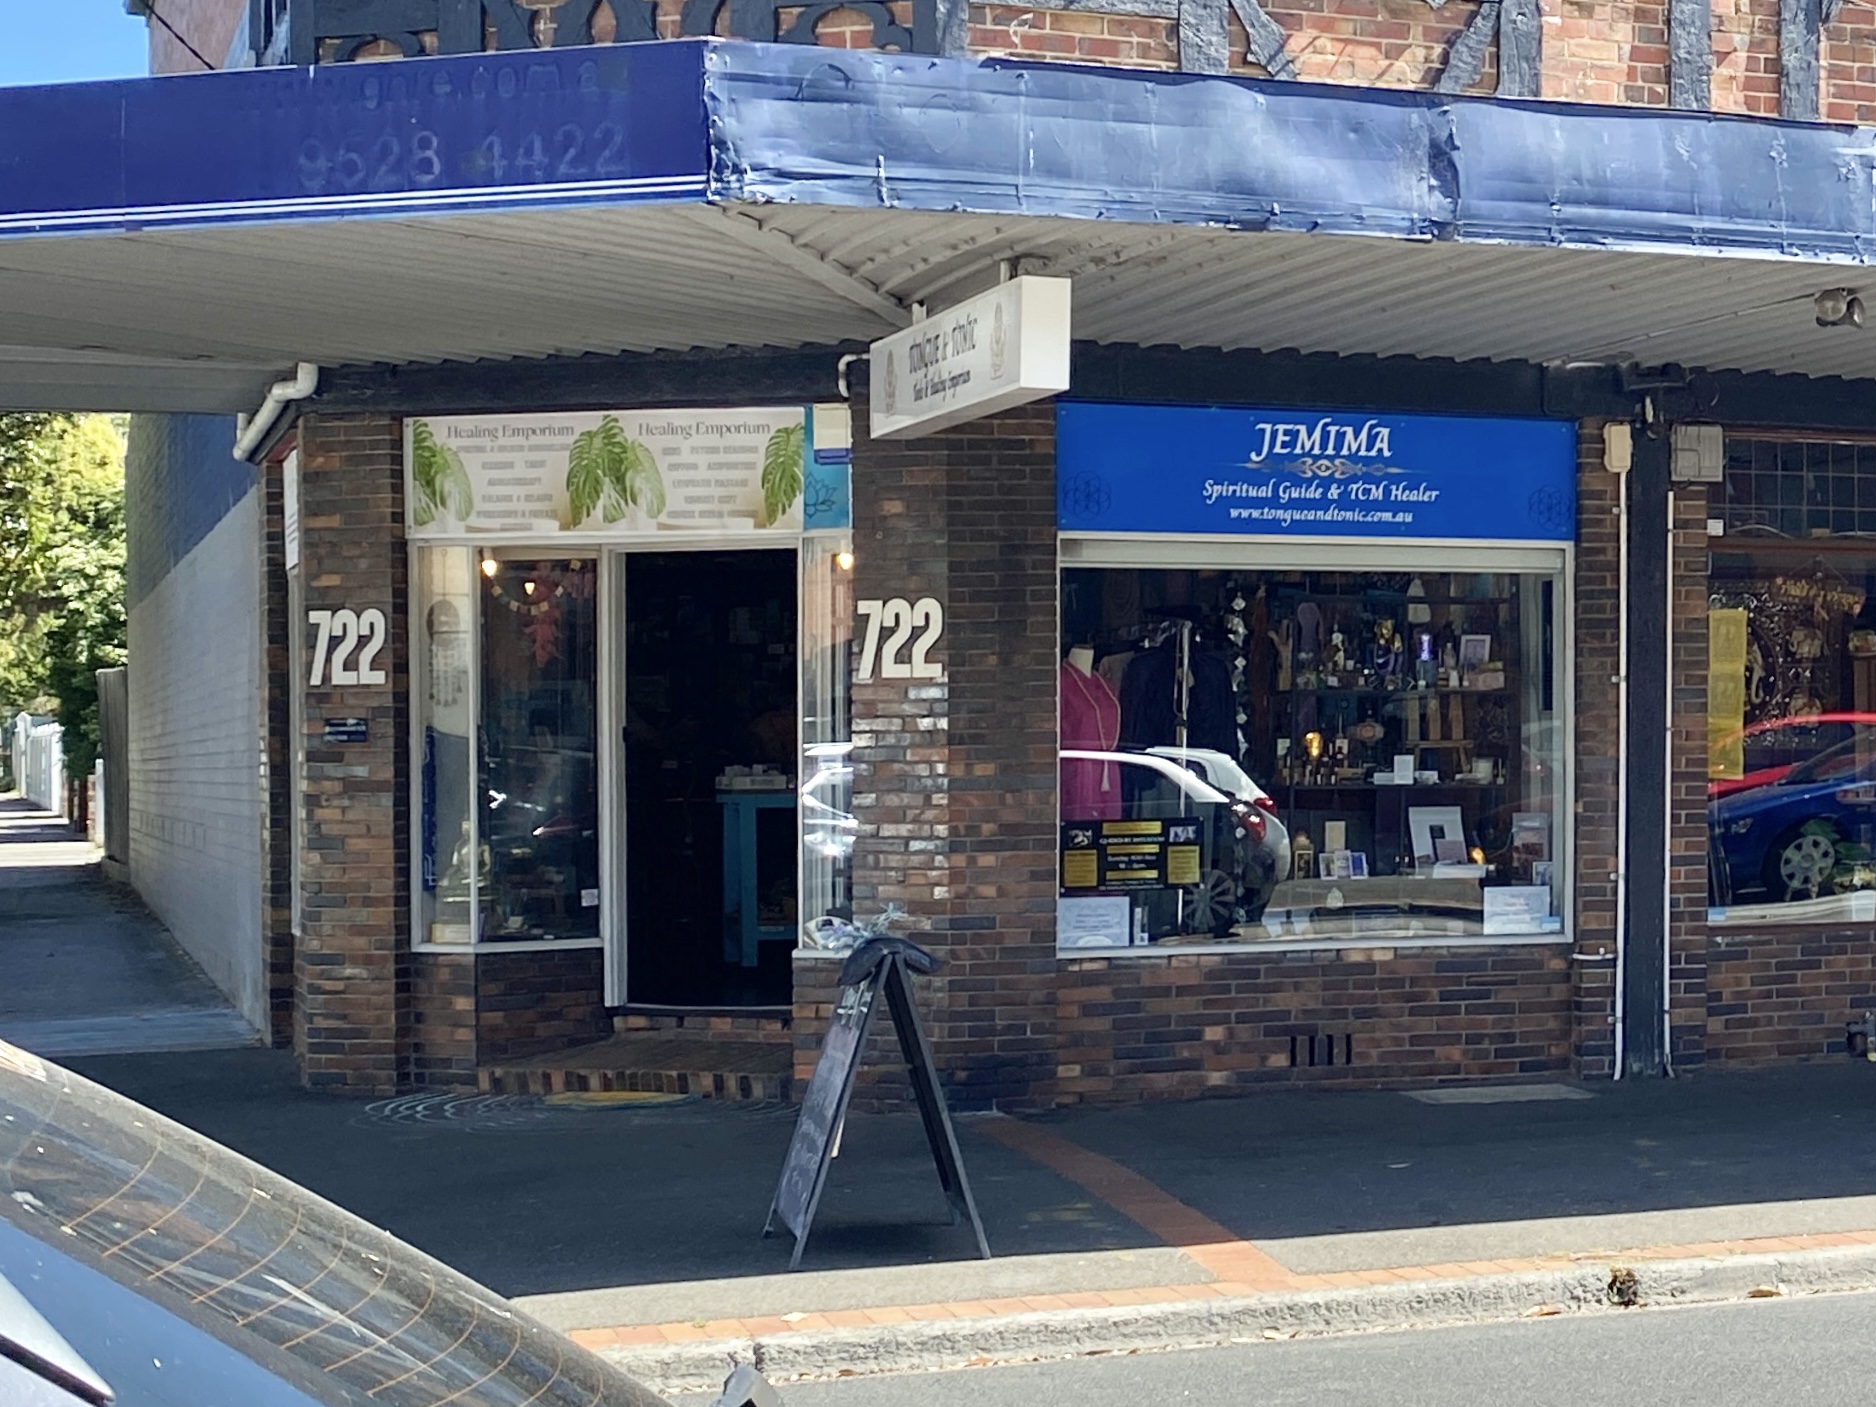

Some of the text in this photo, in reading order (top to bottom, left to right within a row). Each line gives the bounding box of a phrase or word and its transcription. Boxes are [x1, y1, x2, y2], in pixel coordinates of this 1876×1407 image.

[300, 121, 628, 192] 9528 4422
[447, 423, 575, 443] Healing Emporium
[638, 421, 771, 440] Healing Emporium
[1250, 418, 1393, 462] JEMIMA
[1203, 478, 1440, 504] Spiritual Guide & TCM Healer
[1229, 504, 1414, 527] www.tongueandtonic.com.au
[308, 608, 386, 686] 722
[857, 597, 943, 679] 722
